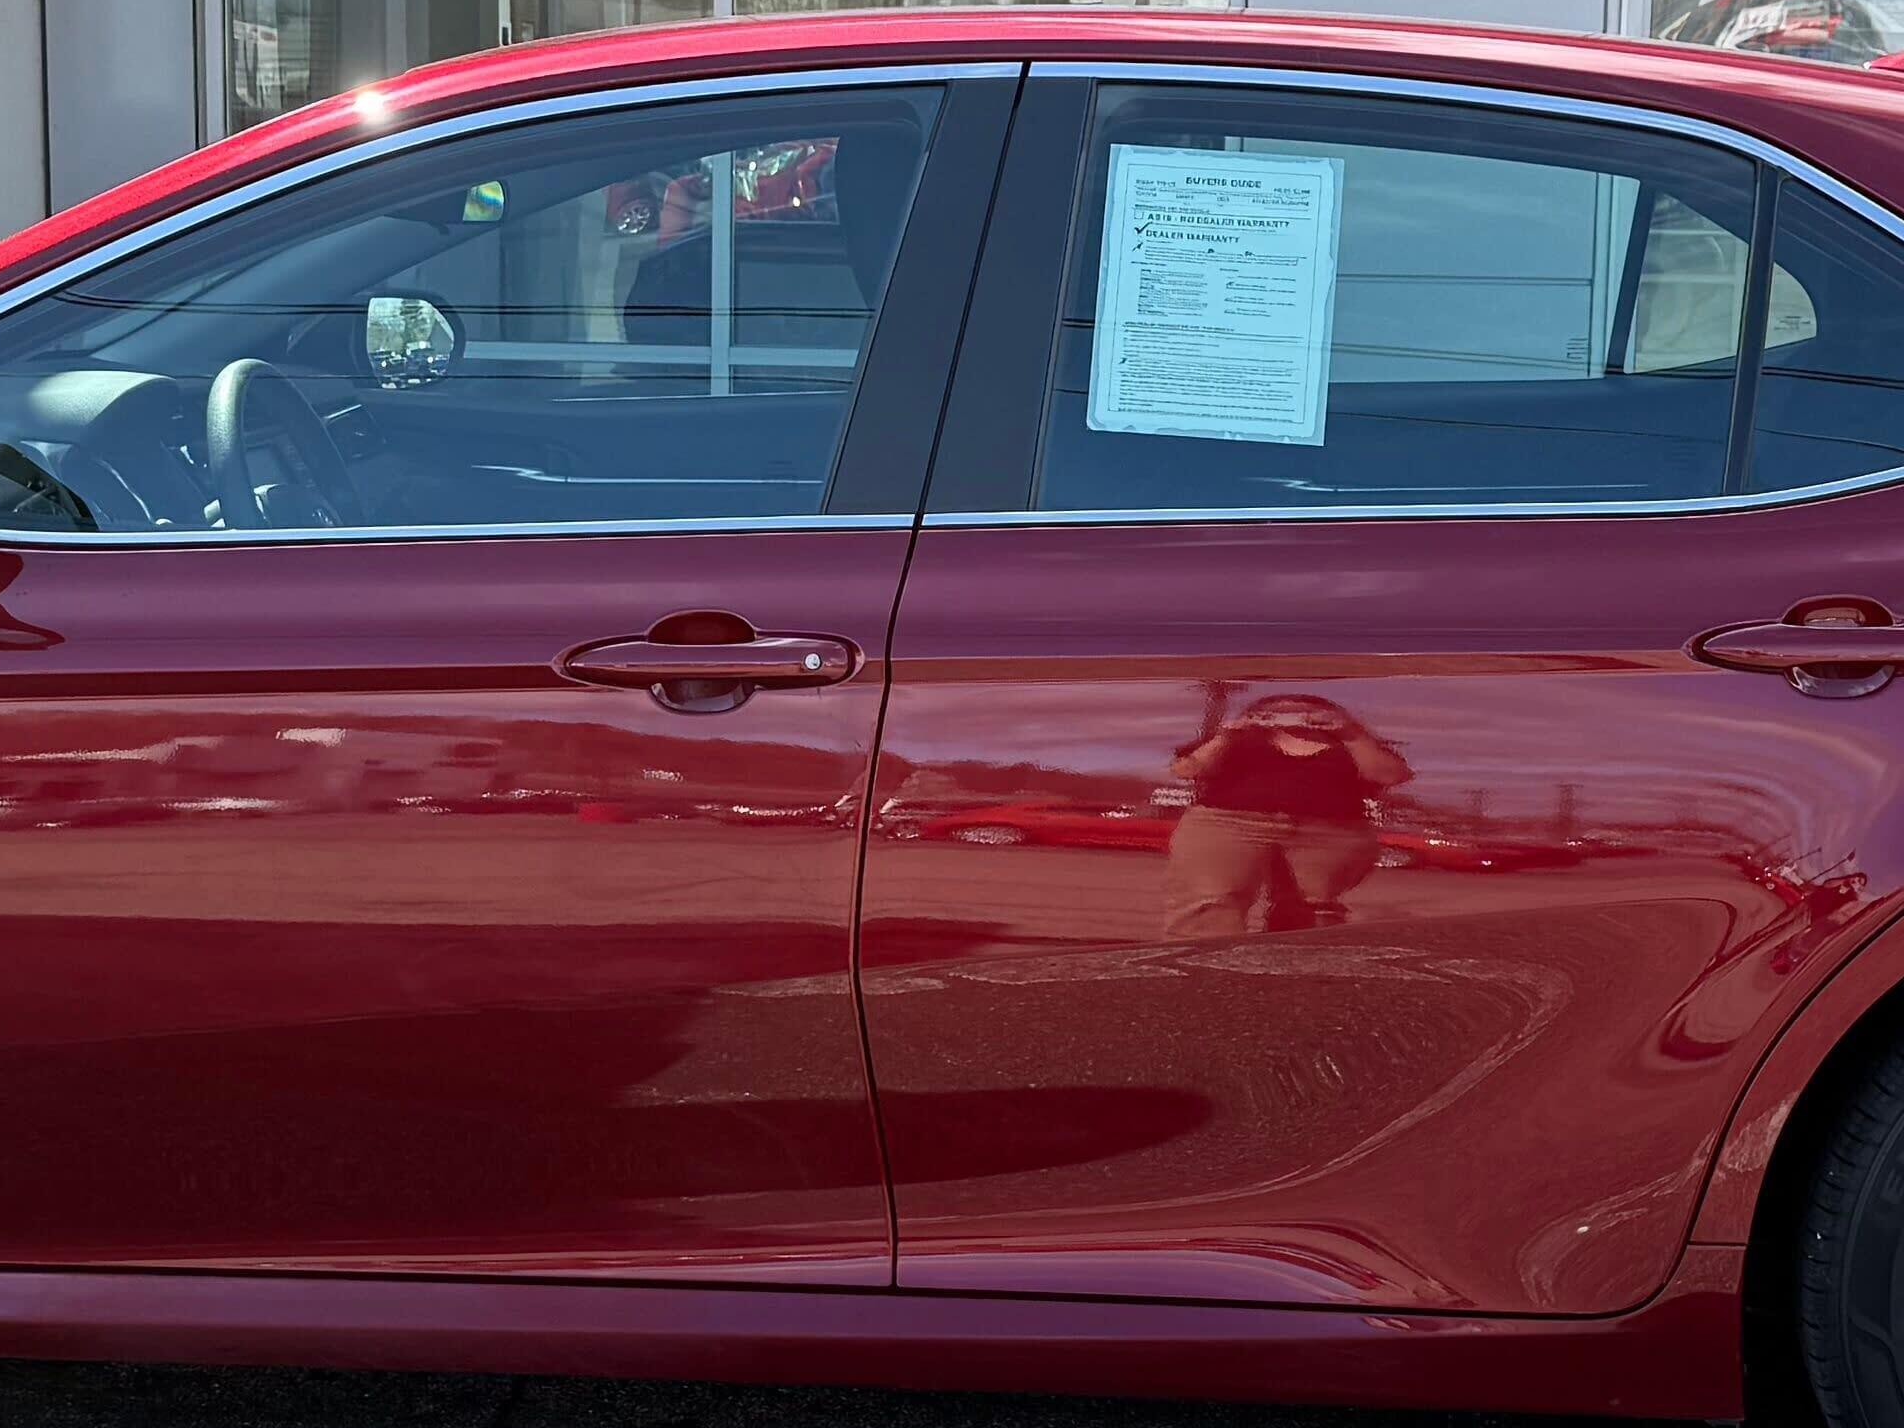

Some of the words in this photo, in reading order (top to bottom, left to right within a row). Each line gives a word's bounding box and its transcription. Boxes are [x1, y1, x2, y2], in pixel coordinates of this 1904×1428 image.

[1237, 218, 1290, 229] WARRANTY
[1146, 230, 1184, 240] DEALER
[1186, 232, 1240, 244] WARRANTY
